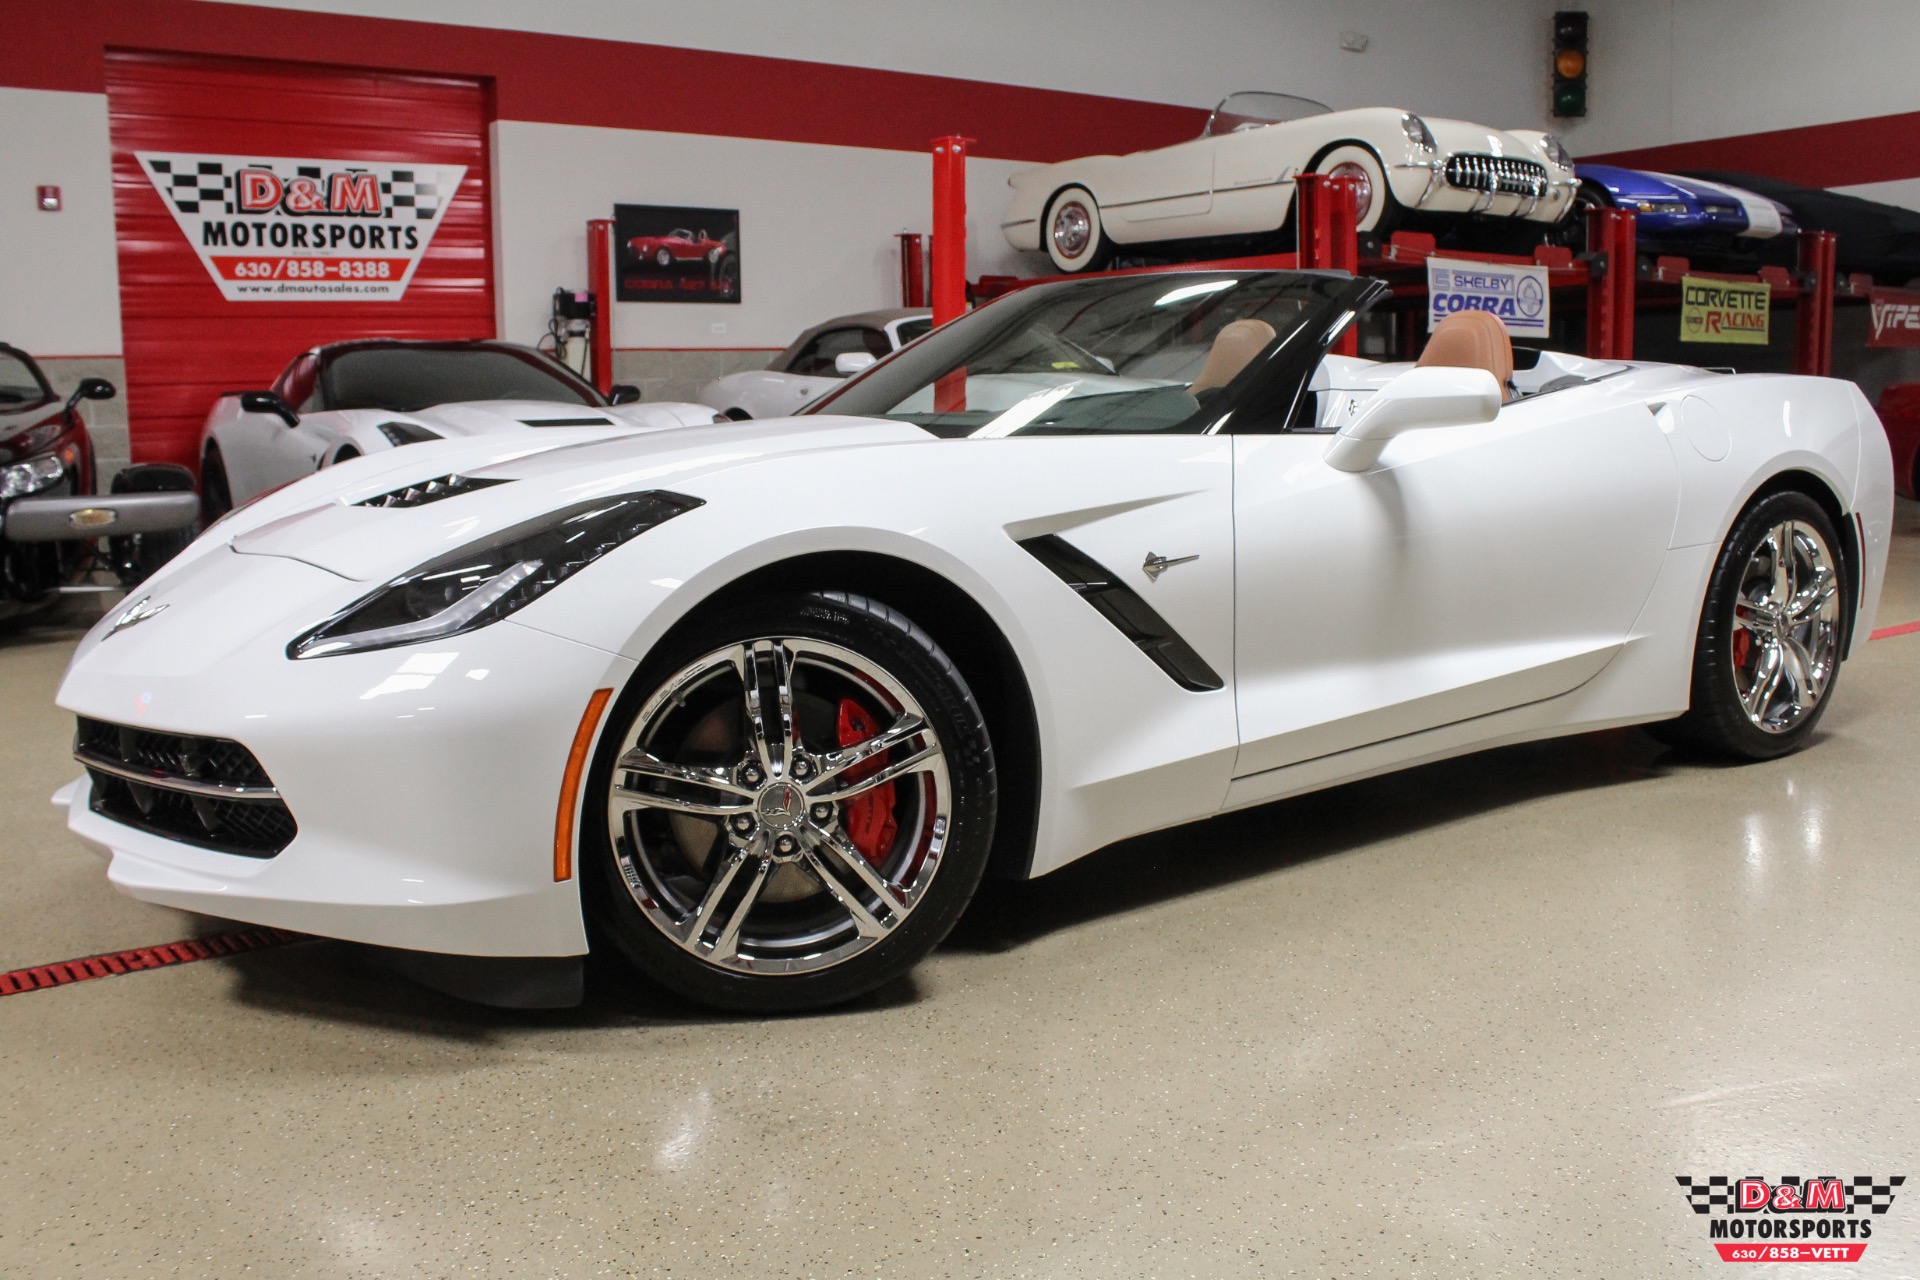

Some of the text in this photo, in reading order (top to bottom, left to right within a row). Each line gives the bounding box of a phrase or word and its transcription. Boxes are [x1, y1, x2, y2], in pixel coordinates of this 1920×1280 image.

[236, 168, 383, 218] D&M
[203, 222, 418, 249] MOTORSPORTS
[234, 260, 391, 279] 630/858-8388
[236, 284, 390, 294] www.dmautosales.com
[1454, 275, 1509, 290] SHELBY
[1433, 293, 1516, 316] COBRA
[1686, 286, 1766, 310] CORVETTE
[1705, 311, 1764, 334] RACING
